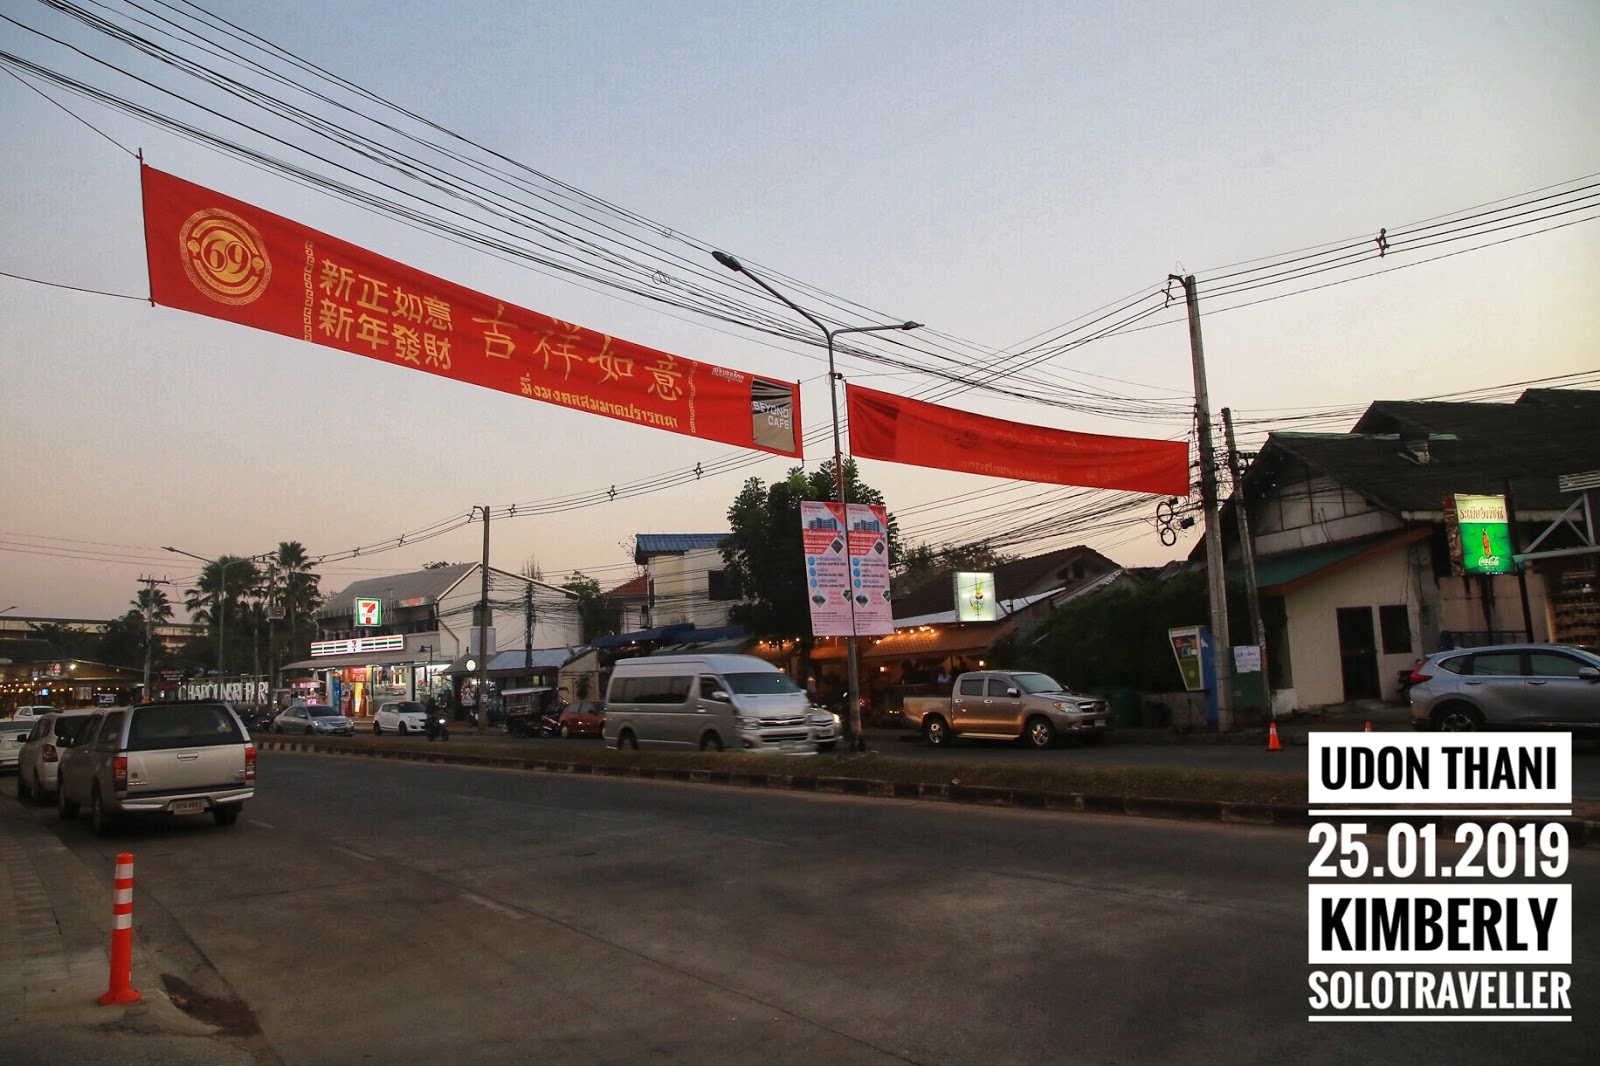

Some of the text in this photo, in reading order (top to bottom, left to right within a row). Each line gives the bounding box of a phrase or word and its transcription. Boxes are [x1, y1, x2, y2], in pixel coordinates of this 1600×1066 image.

[319, 258, 454, 332] 新正如意
[319, 298, 452, 370] 新年發財
[752, 400, 789, 419] BEYOND
[767, 415, 790, 430] CAFE
